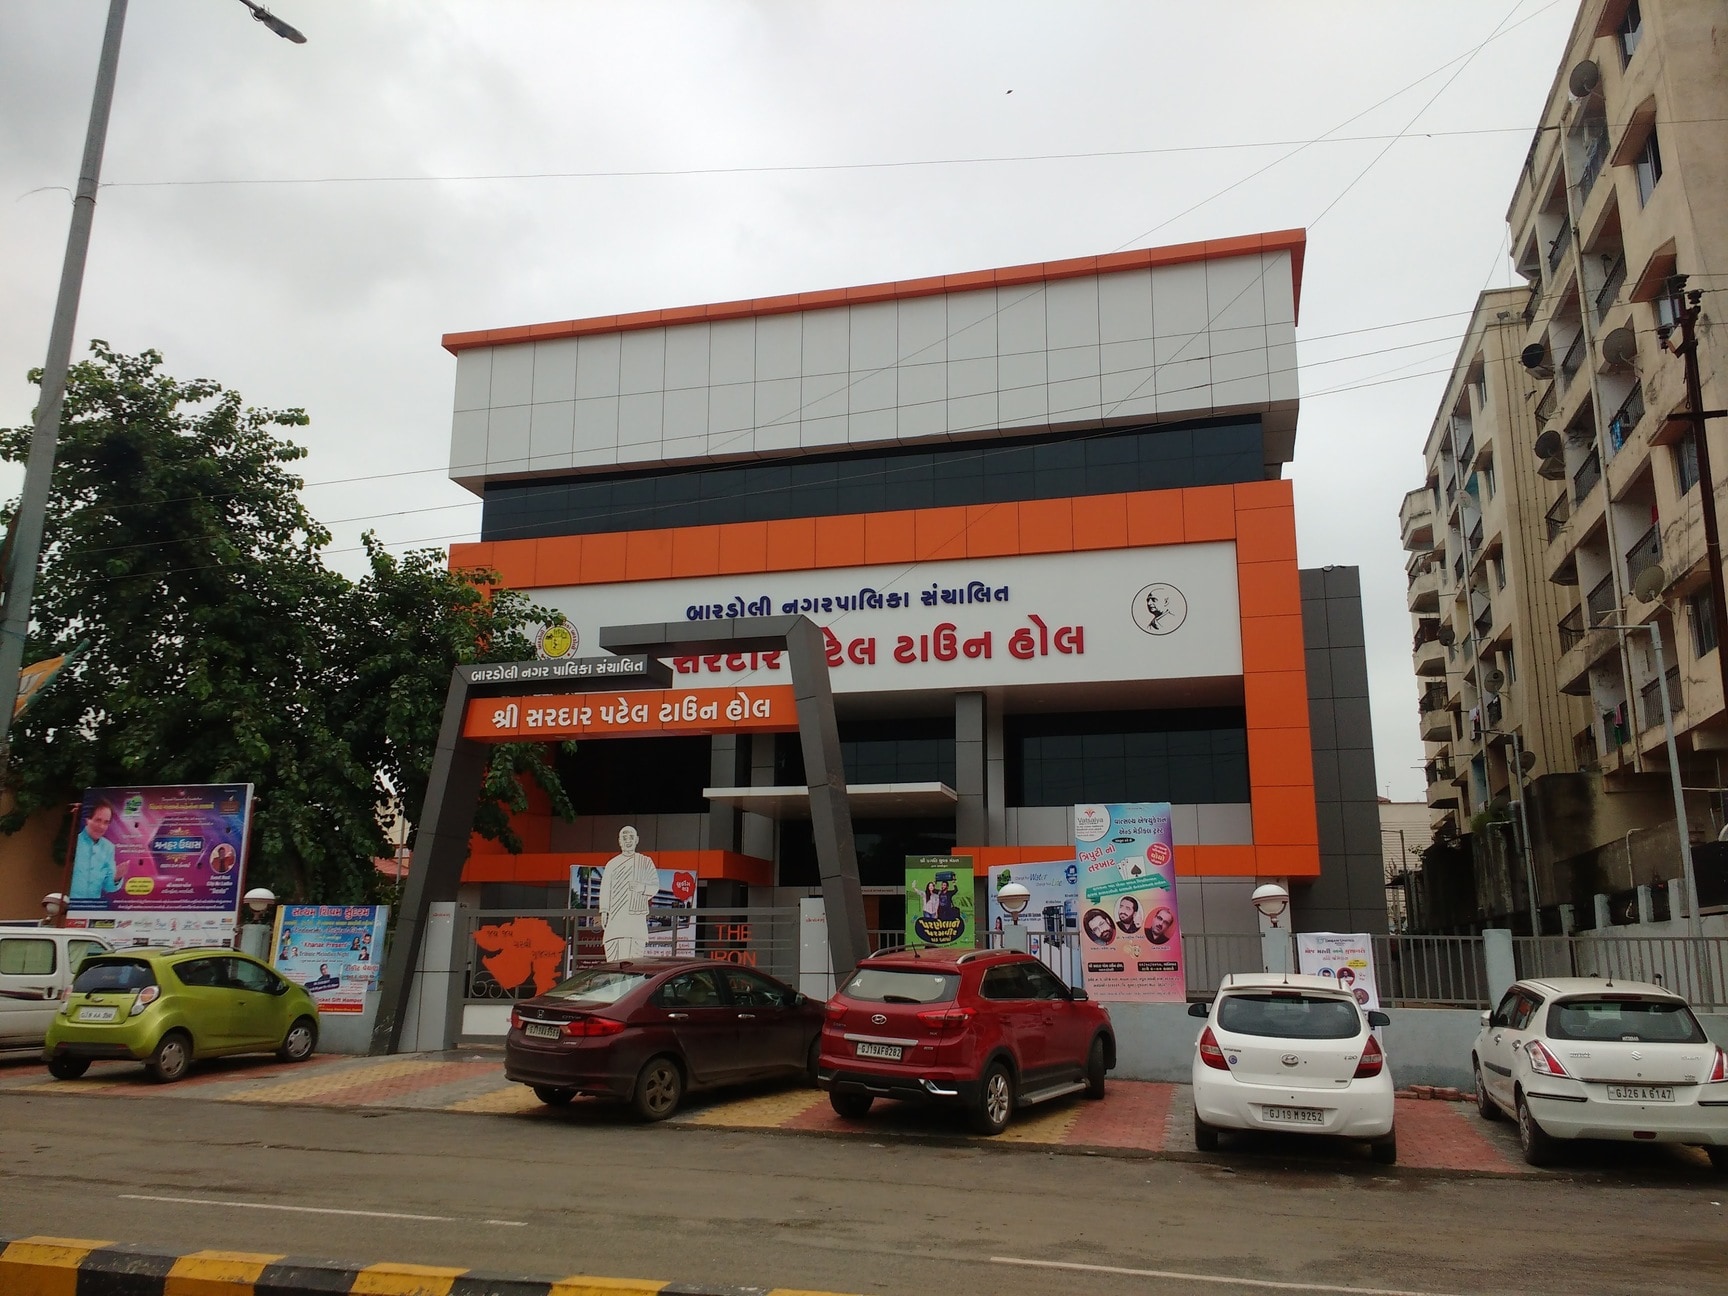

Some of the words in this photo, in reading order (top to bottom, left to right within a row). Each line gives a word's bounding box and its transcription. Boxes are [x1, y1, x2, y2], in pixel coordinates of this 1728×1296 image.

[686, 595, 772, 621] બારડોલી
[781, 587, 910, 615] નગરપાલિકા
[920, 580, 1009, 607] સંચાલિત
[893, 622, 992, 664] ટાઉન
[1007, 613, 1085, 660] હોલ
[470, 665, 519, 682] બારડોલી
[521, 666, 550, 679] નગર
[552, 660, 593, 676] પાલિકા
[595, 658, 644, 675] સંચાલિત
[491, 703, 519, 729] શ્રી
[526, 706, 593, 728] સરદાર
[599, 696, 649, 725] પટેલ
[658, 695, 718, 722] ટાઉન
[725, 691, 771, 721] હોલ
[715, 924, 753, 942] THE
[710, 949, 758, 967] IRON
[1641, 1089, 1647, 1099] A
[1649, 1089, 1672, 1100] 6147
[1301, 1111, 1322, 1122] 9252
